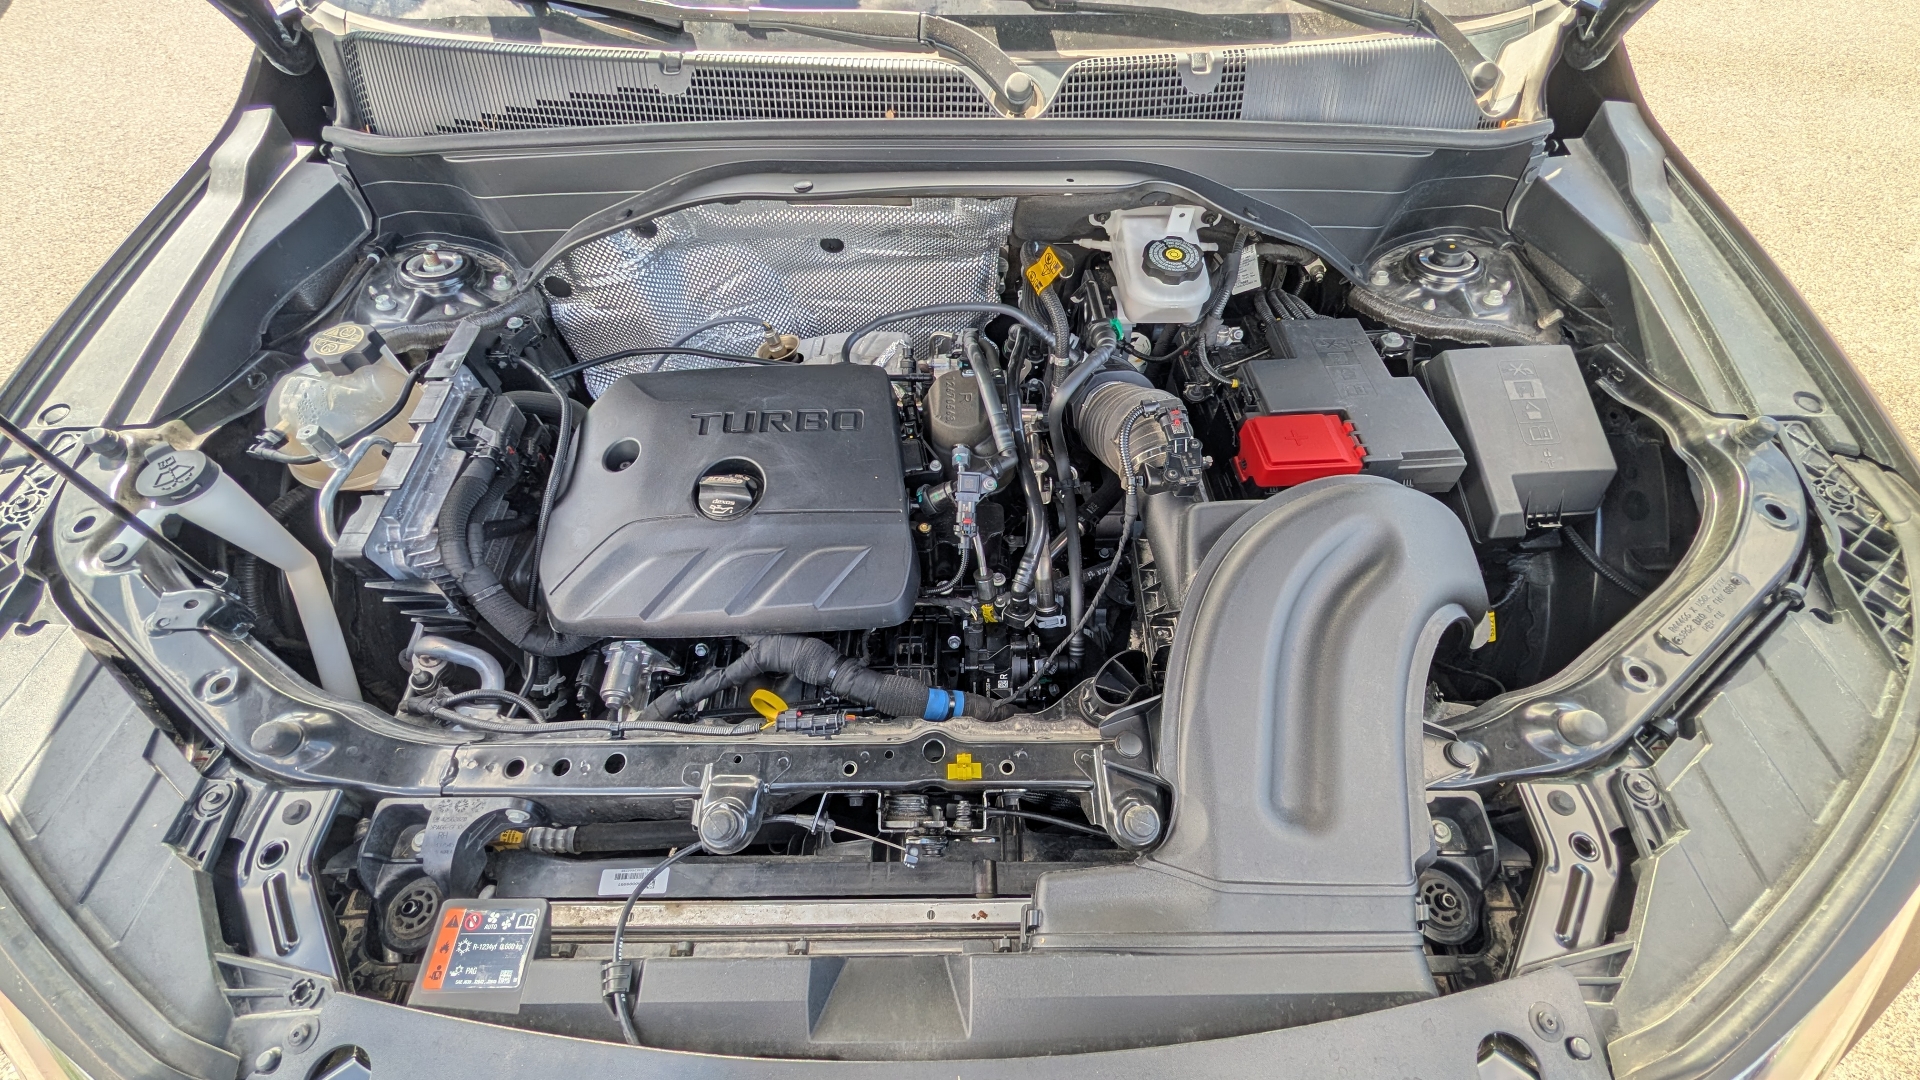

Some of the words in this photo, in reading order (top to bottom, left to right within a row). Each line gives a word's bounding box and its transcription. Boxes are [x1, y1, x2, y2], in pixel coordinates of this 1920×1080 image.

[691, 408, 865, 435] TURBO
[438, 831, 449, 839] RH
[472, 943, 498, 952] R-1234yf
[465, 966, 478, 975] PAG
